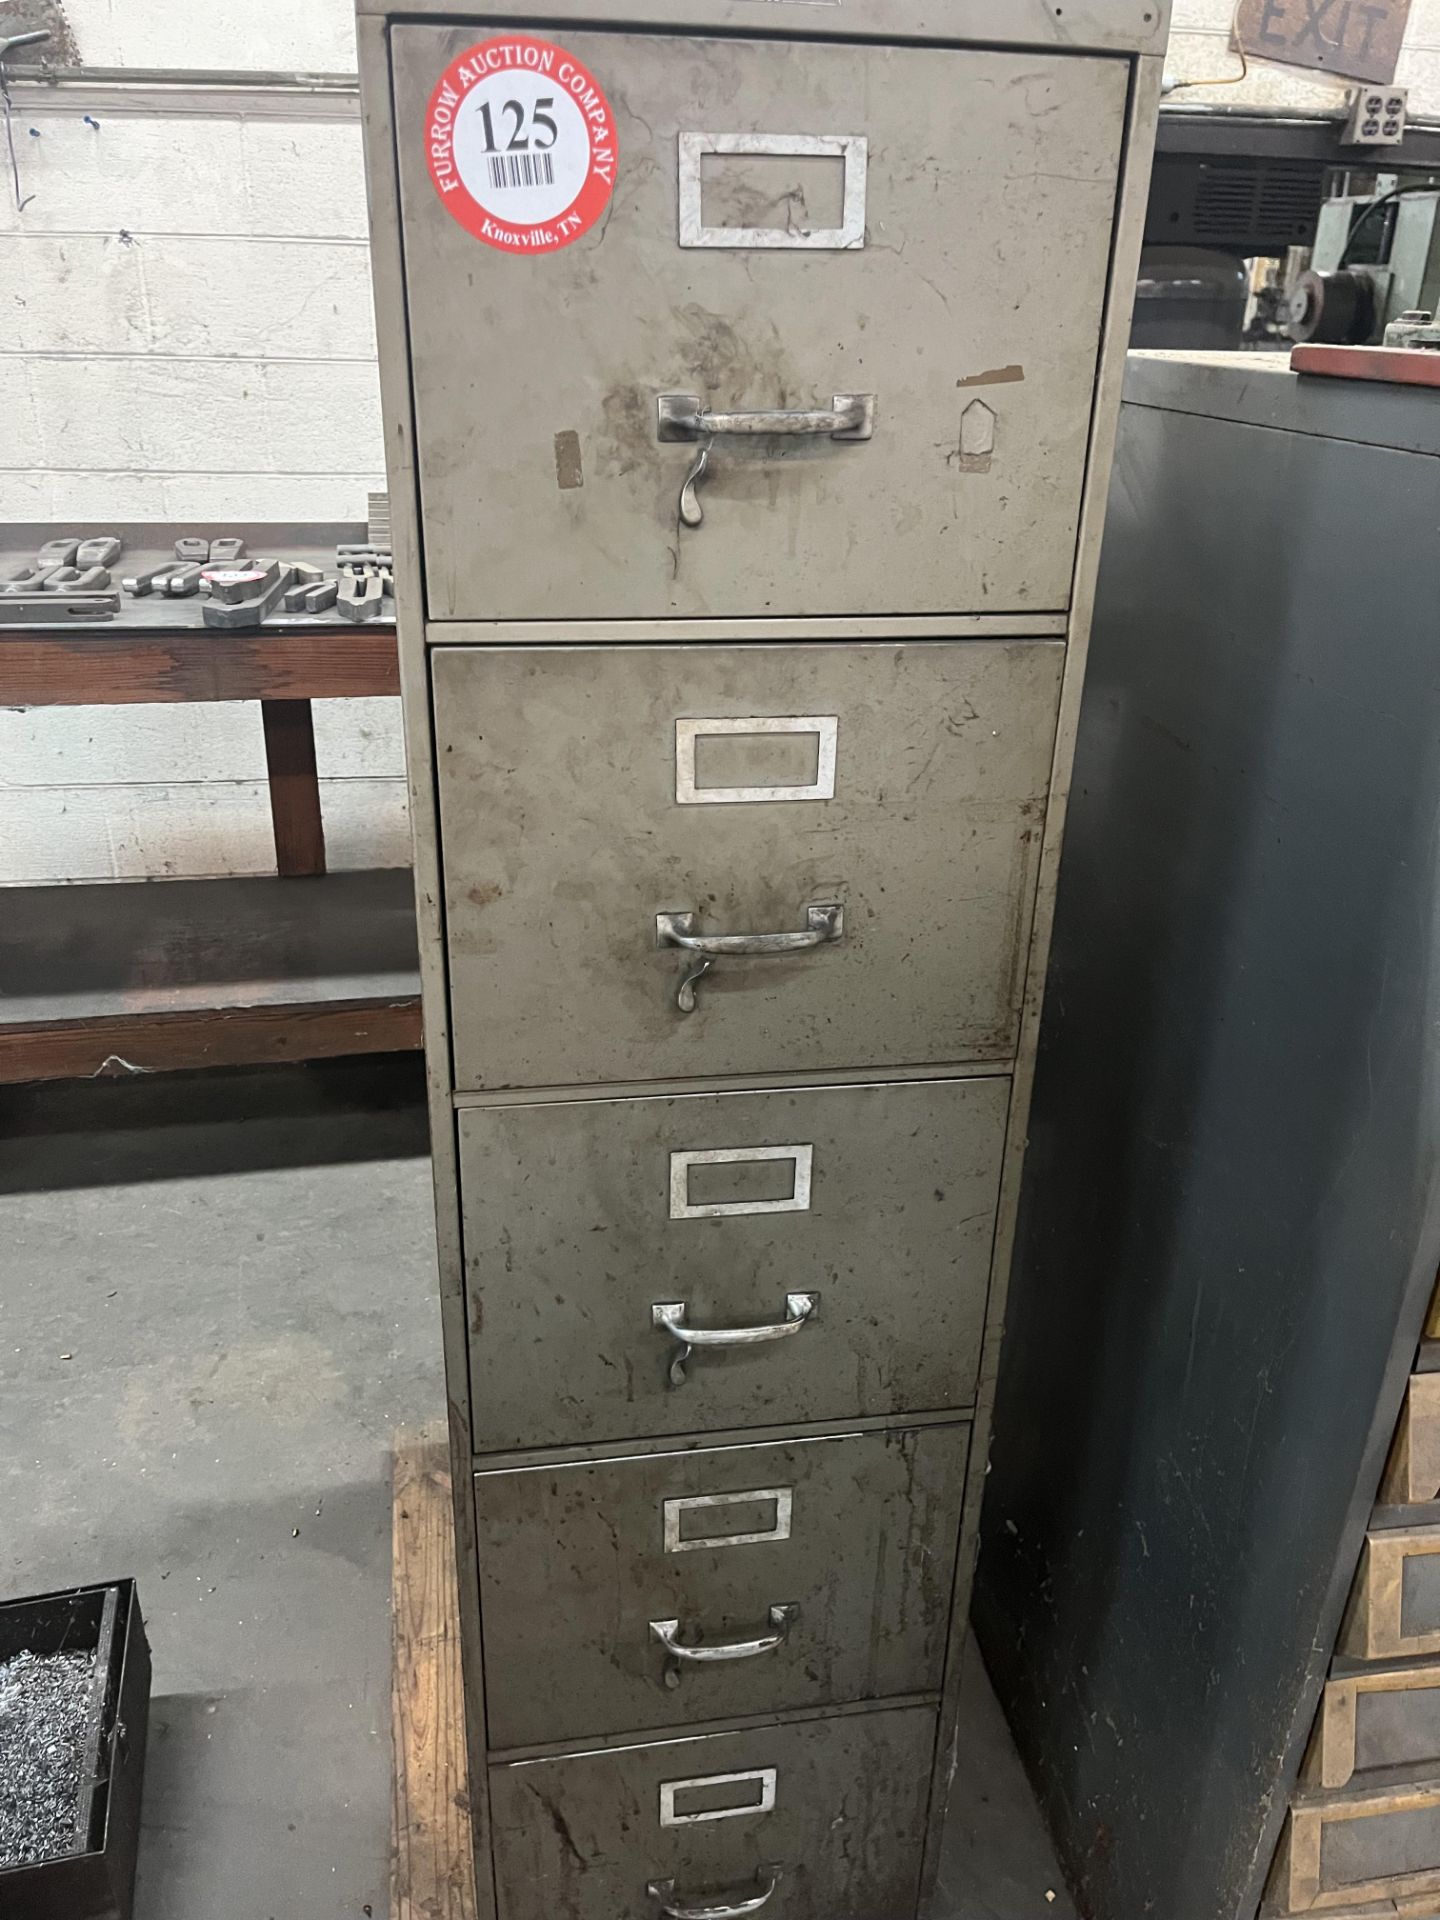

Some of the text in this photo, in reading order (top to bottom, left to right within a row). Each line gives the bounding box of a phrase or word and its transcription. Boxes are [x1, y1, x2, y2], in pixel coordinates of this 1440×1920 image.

[1259, 0, 1388, 61] EXIT
[431, 45, 614, 193] FURROW AUCTION COMPANY
[475, 97, 558, 153] 125
[480, 211, 583, 247] Knoxville, TN
